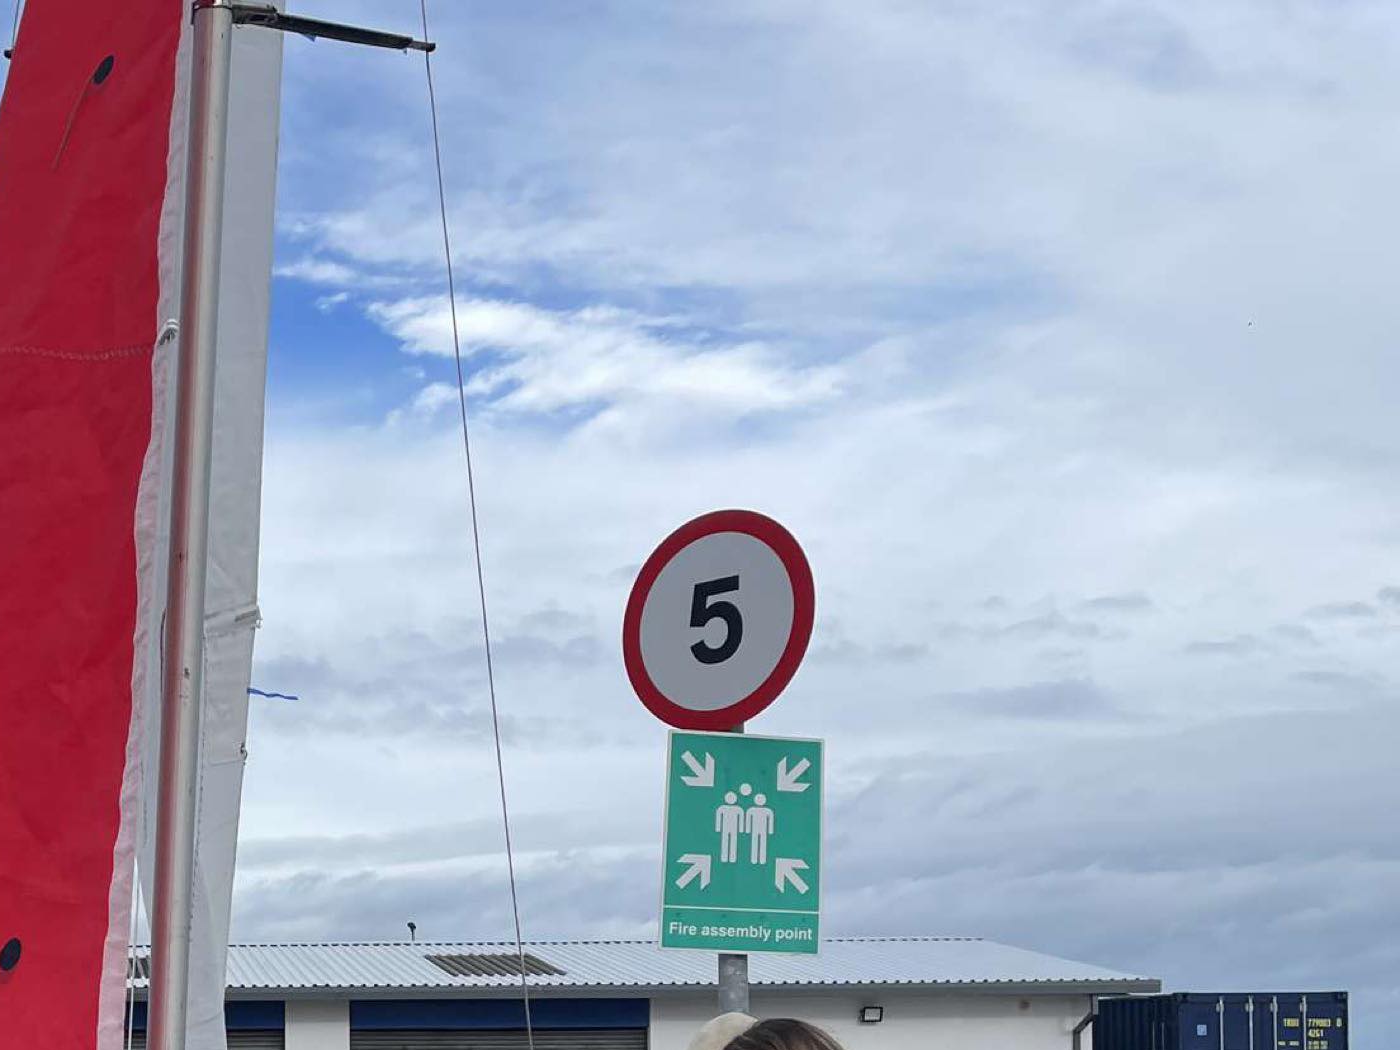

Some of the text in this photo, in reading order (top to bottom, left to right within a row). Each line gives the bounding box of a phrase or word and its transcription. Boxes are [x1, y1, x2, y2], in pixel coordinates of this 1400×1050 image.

[689, 575, 743, 664] 5
[669, 921, 813, 942] Fire assembly point
